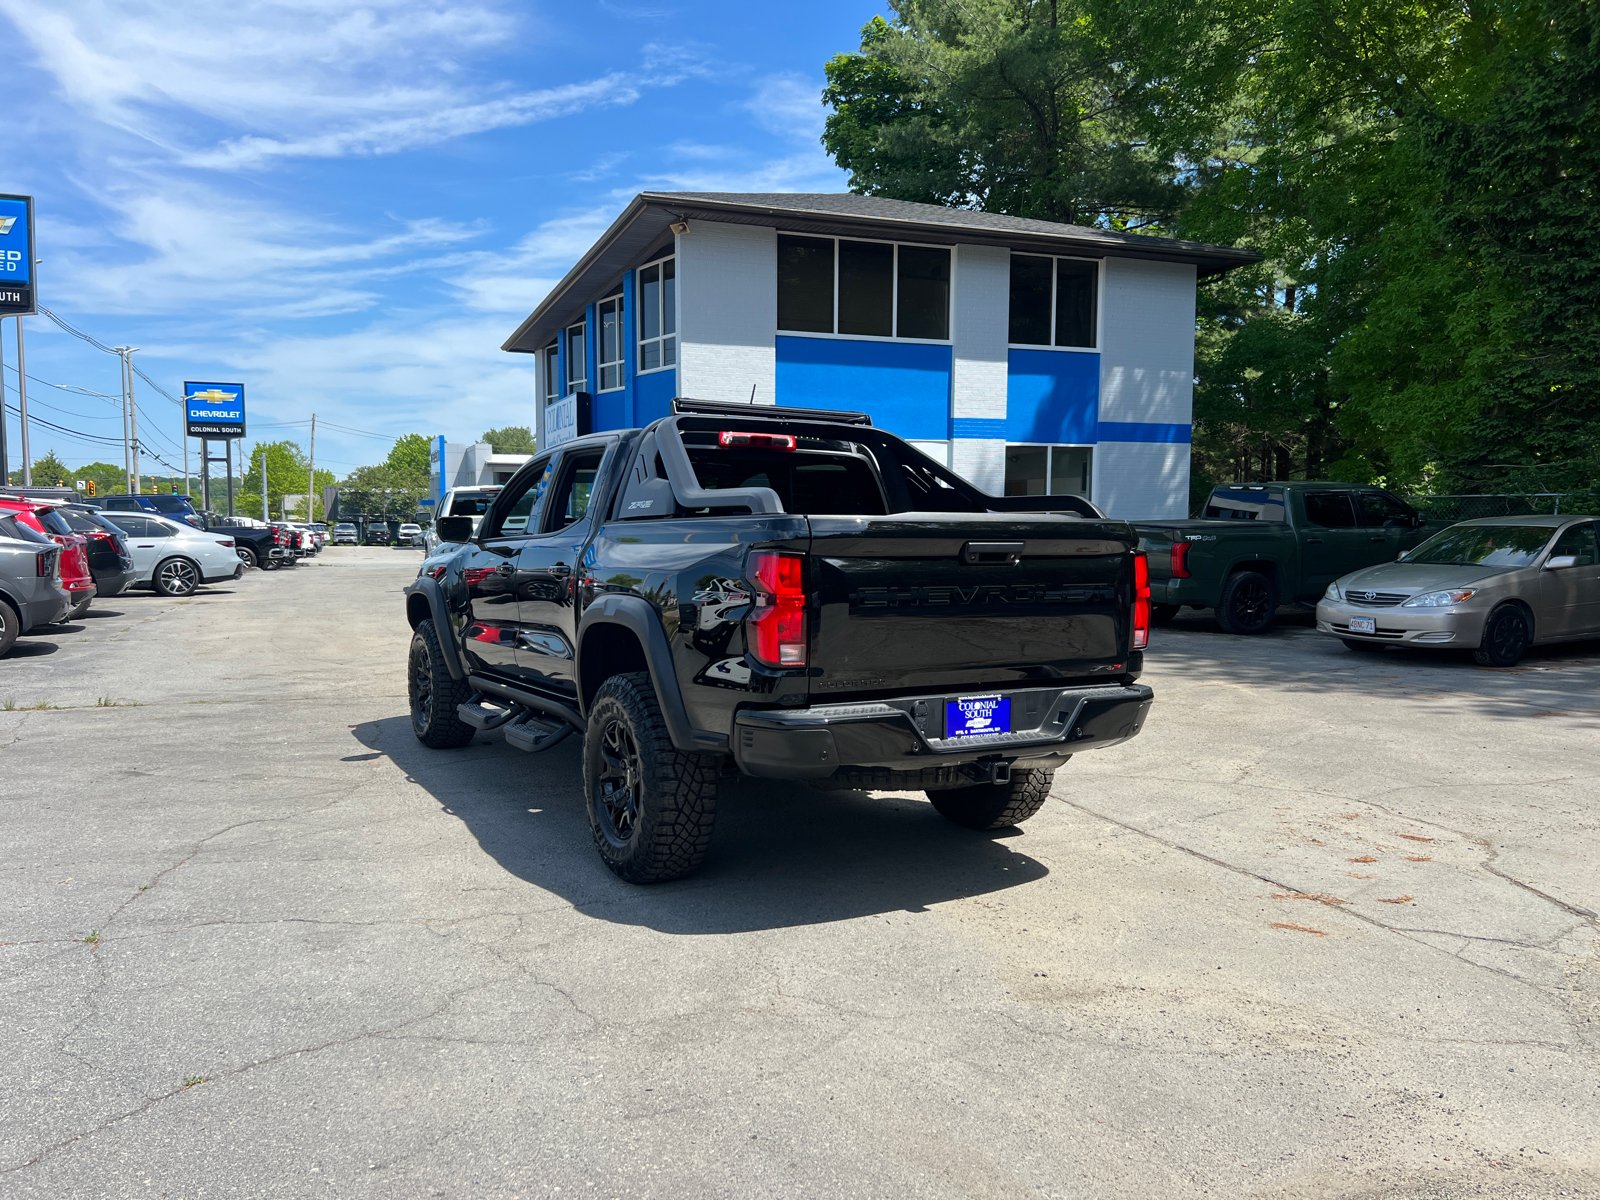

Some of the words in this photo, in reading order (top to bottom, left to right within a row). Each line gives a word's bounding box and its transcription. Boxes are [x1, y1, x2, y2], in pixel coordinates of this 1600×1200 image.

[191, 410, 240, 418] CHEVROLET
[628, 500, 653, 509] ZR2
[692, 591, 744, 602] ZR2
[857, 584, 1115, 607] CHEVROLET
[818, 678, 886, 689] COLORADO
[959, 701, 998, 711] COLONIAL
[965, 709, 992, 718] SOUTH
